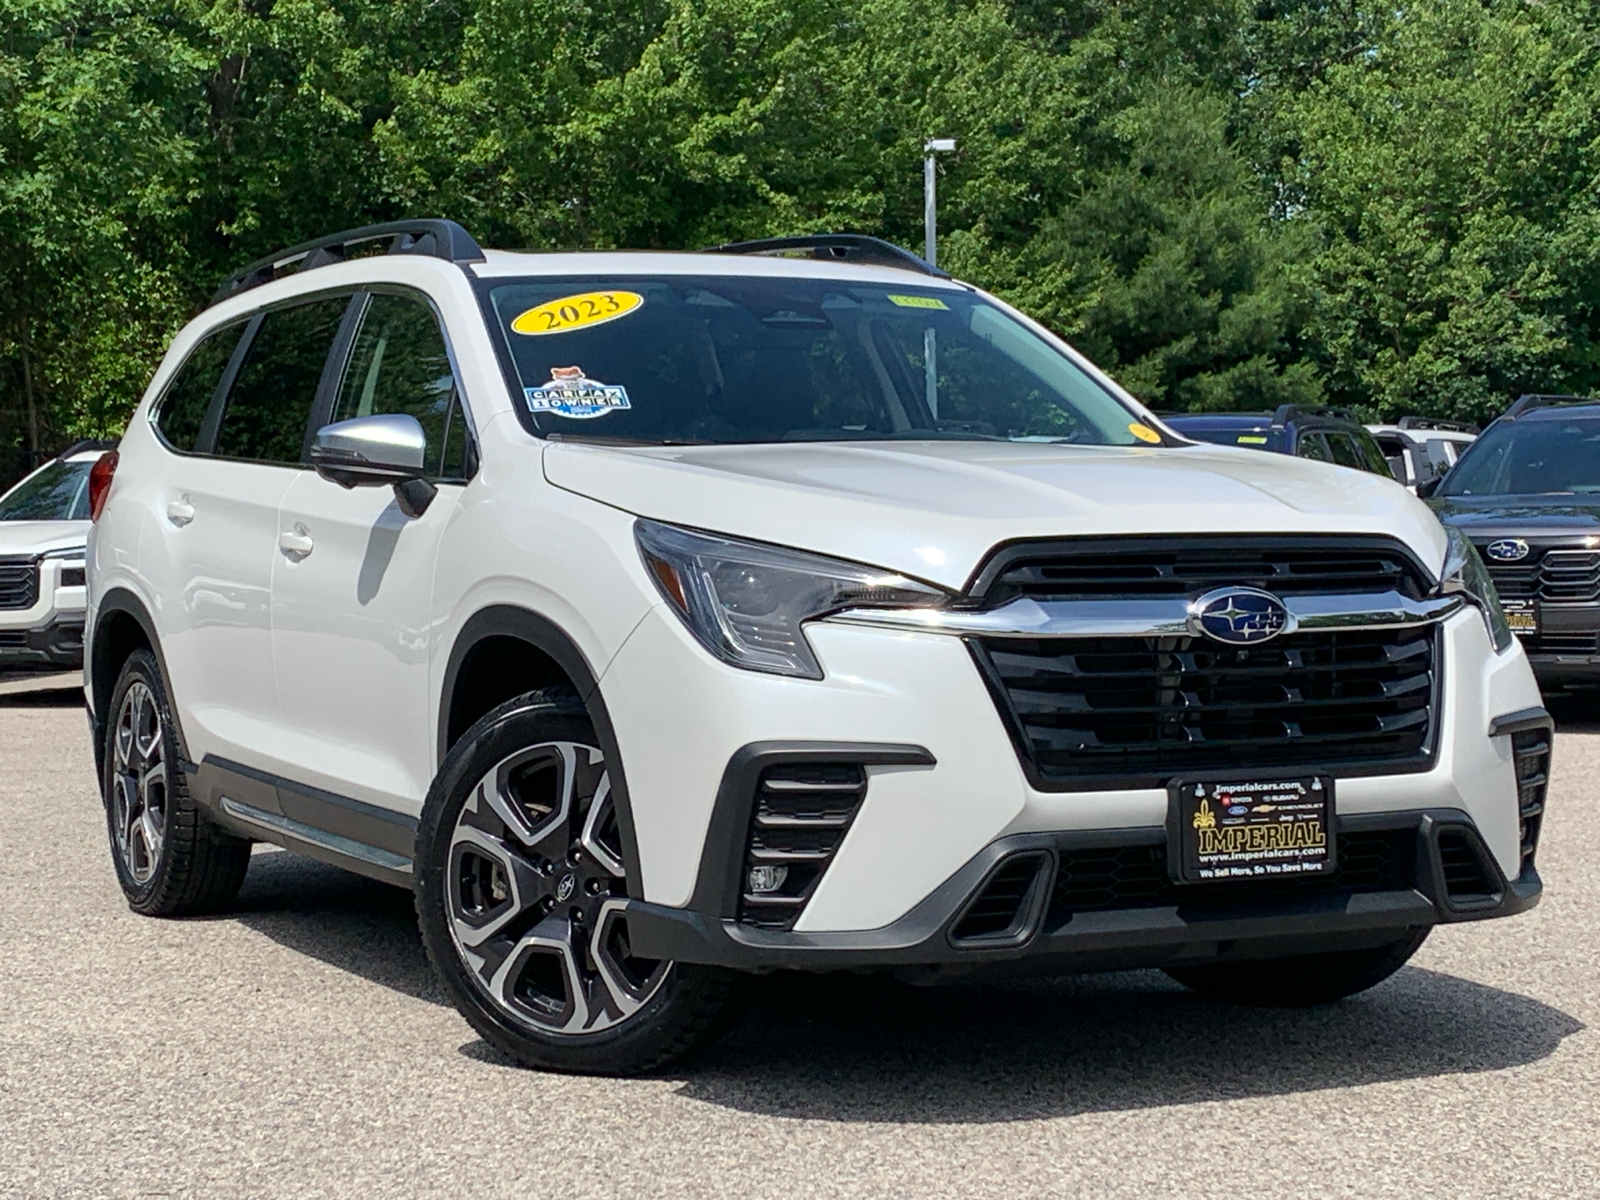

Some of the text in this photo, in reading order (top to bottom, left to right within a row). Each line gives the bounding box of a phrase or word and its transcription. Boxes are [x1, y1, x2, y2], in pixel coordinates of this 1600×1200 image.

[539, 295, 620, 330] 2023
[532, 389, 618, 399] CARFAX
[551, 398, 621, 407] OWNER
[1215, 782, 1301, 794] Imperialcars.com
[1271, 794, 1299, 802] SUBARU
[1277, 803, 1324, 811] CHEVROLET
[1199, 821, 1326, 854] IMPERIAL
[1199, 847, 1326, 862] www.imperialcars.com
[1200, 869, 1213, 878] We
[1214, 867, 1229, 877] Sell
[1254, 864, 1265, 874] So
[1265, 863, 1281, 872] You
[1282, 862, 1301, 872] Save
[1302, 862, 1322, 871] More
